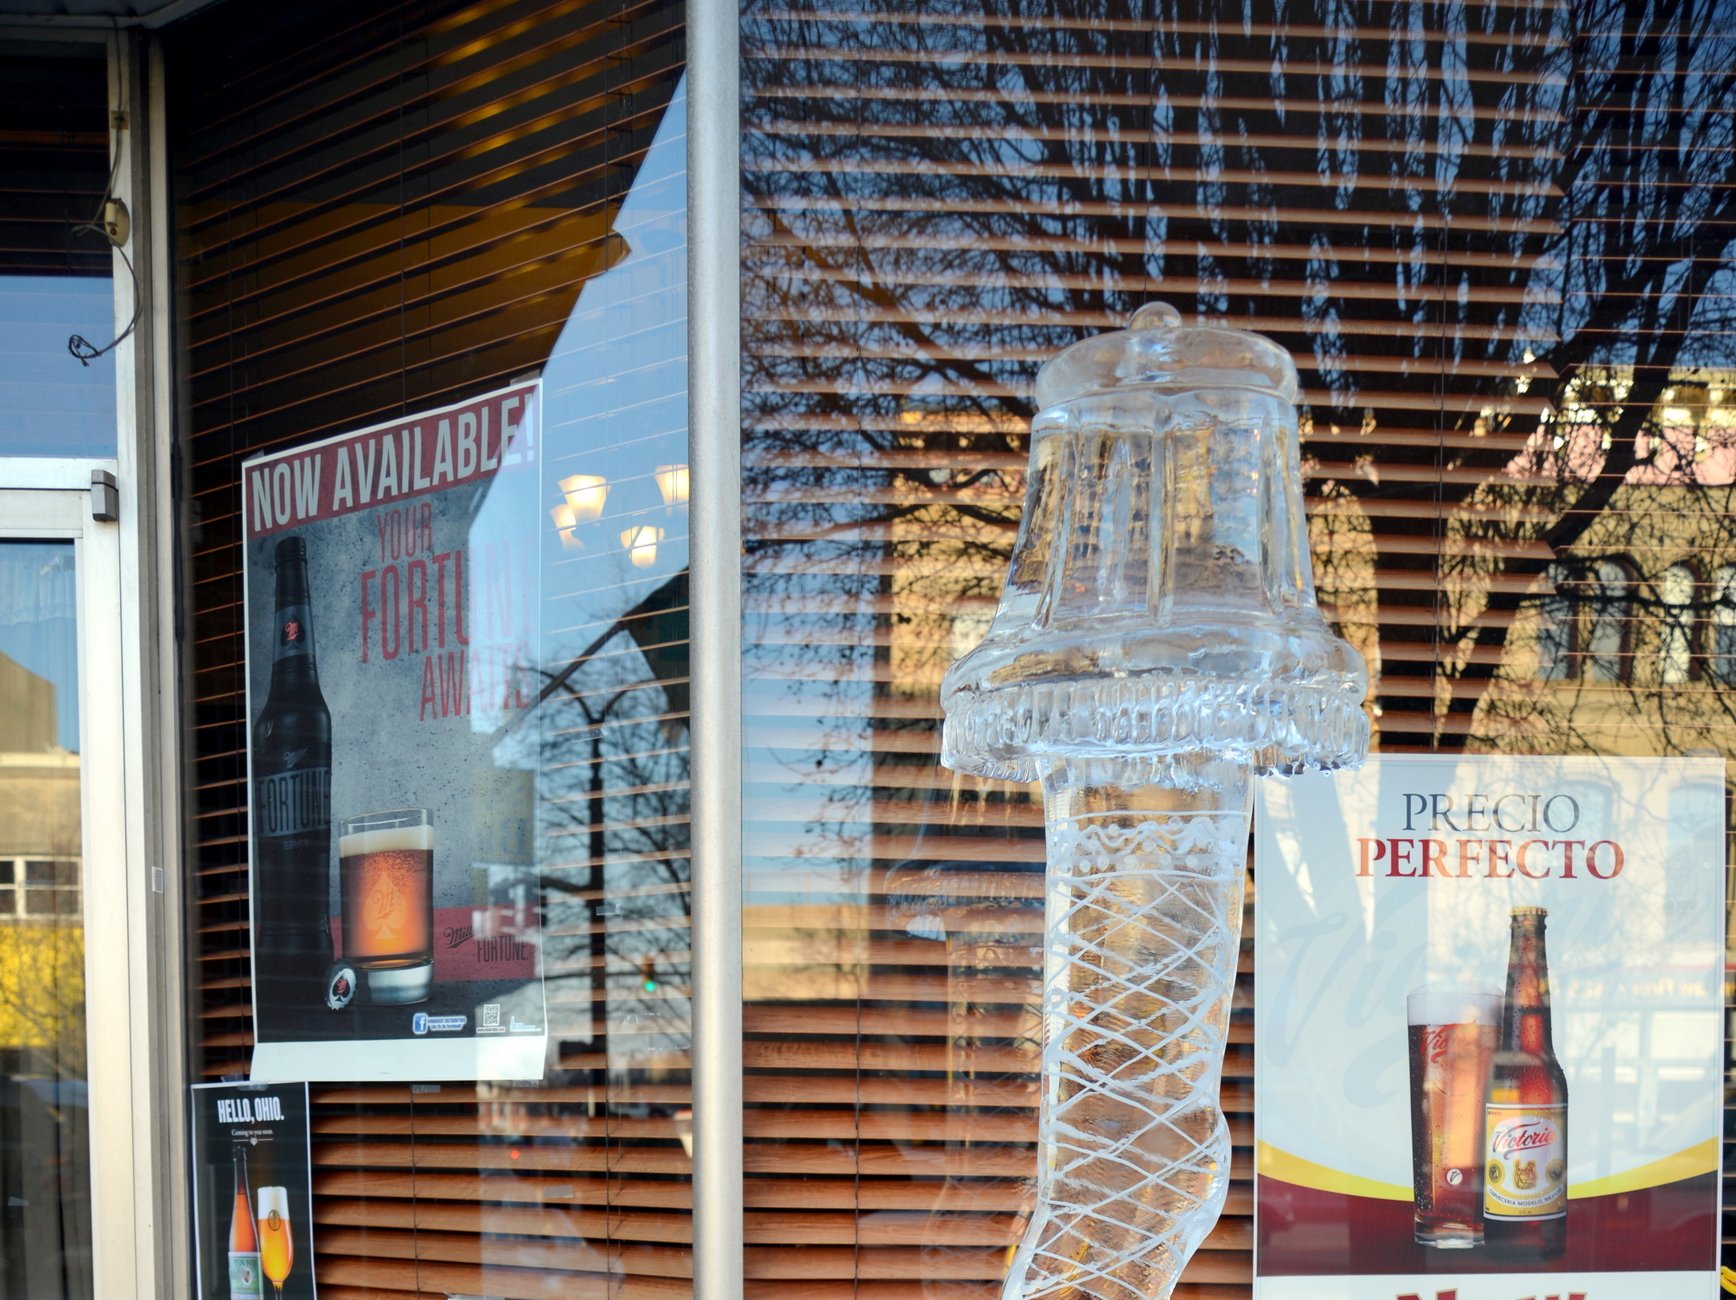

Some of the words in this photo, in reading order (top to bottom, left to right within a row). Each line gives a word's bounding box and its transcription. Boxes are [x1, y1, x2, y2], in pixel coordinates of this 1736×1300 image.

[252, 453, 321, 531] NOW
[333, 393, 535, 511] AVAILABLE!
[377, 502, 432, 563] YOUR
[361, 536, 534, 663] FORTUNE
[420, 639, 533, 721] AWAITS
[255, 769, 331, 834] FORTUNE
[1401, 793, 1581, 833] PRECIO
[1355, 837, 1626, 880] PERFECTO
[443, 924, 484, 949] Mill
[217, 1098, 255, 1124] HELLO,
[254, 1096, 285, 1121] OHIO.
[1488, 1188, 1516, 1205] CERVECERIA
